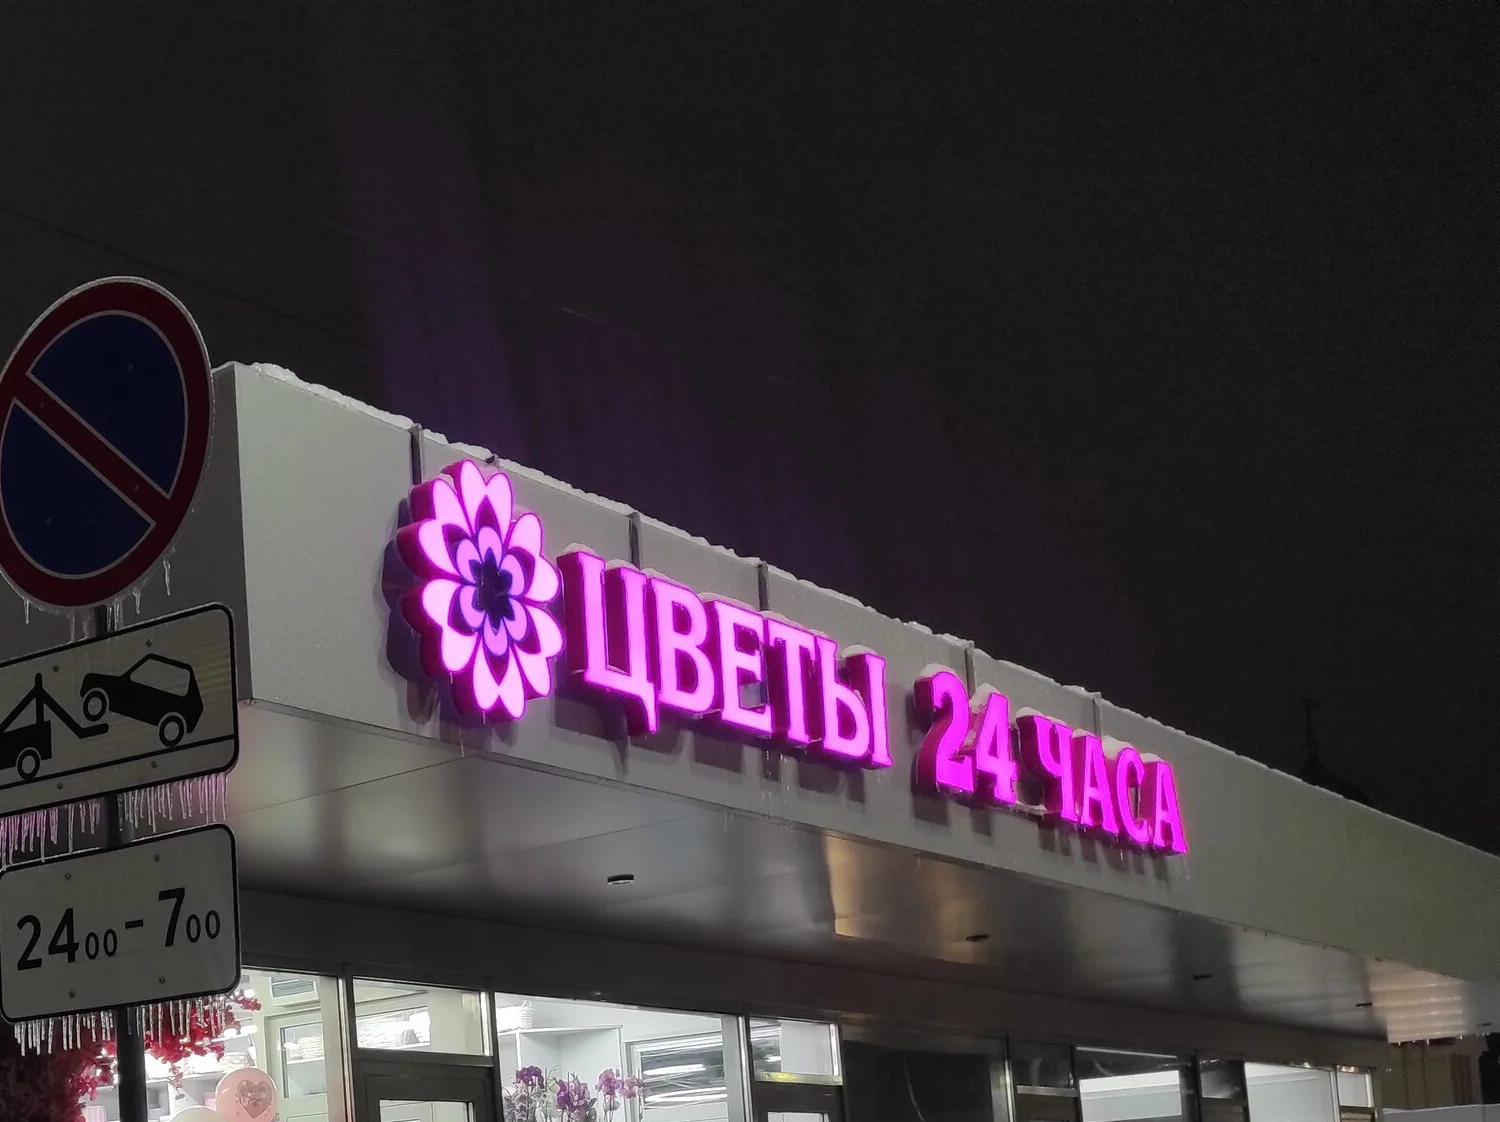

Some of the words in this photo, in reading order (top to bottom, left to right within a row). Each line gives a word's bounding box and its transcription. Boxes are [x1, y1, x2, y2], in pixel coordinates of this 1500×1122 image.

[570, 550, 894, 768] ЦВЕТЫ
[924, 670, 1019, 806] 24
[1028, 714, 1189, 855] ЧАСА
